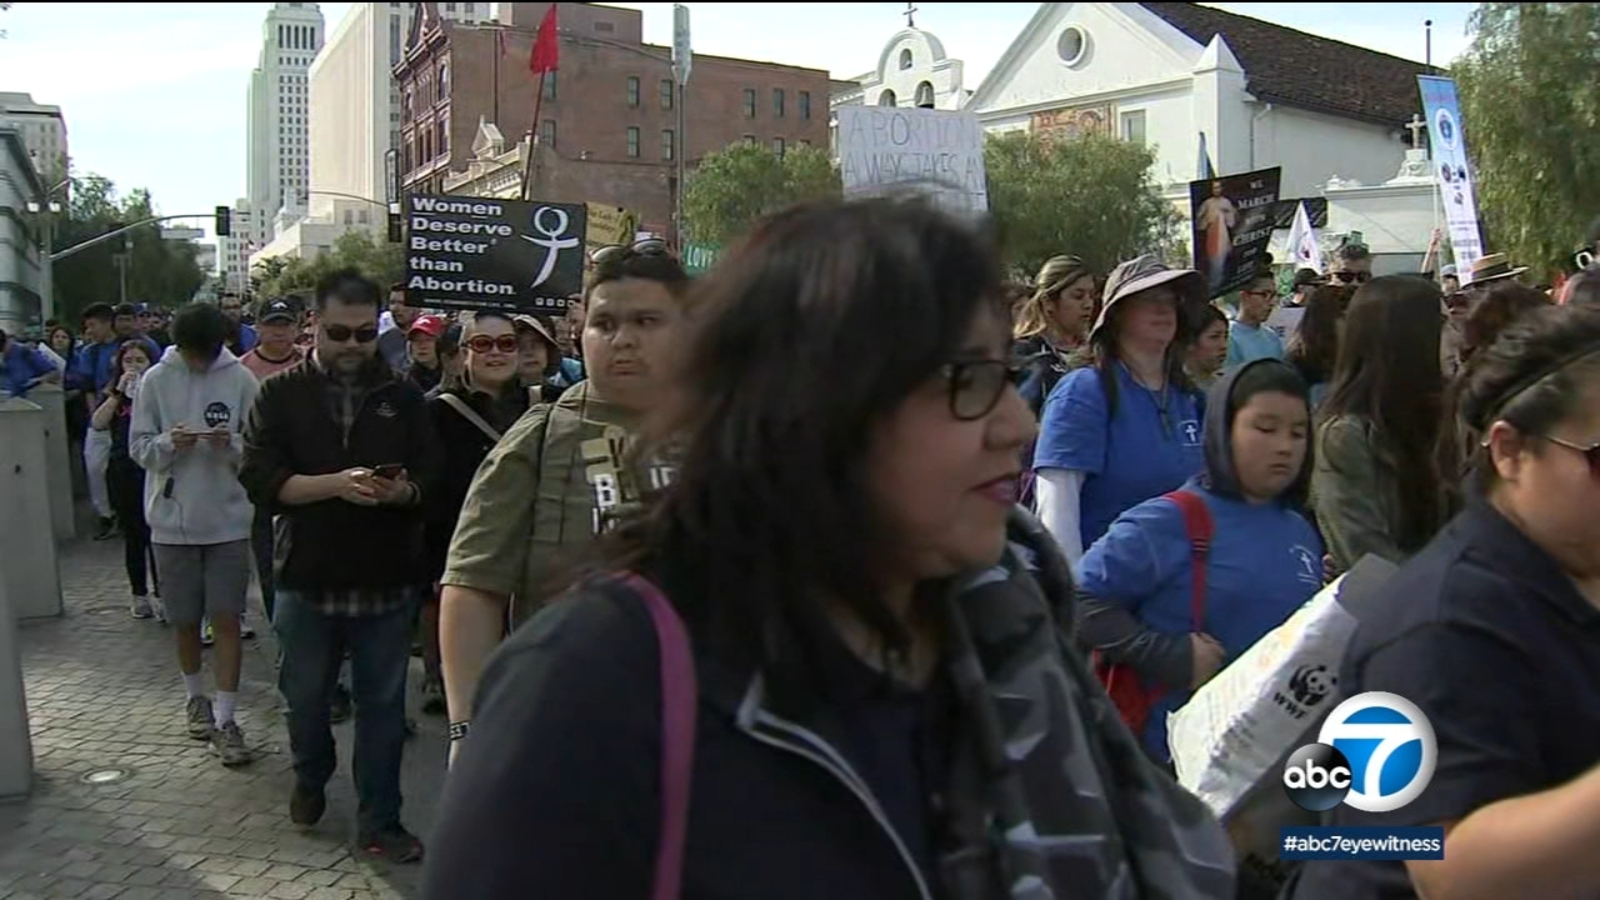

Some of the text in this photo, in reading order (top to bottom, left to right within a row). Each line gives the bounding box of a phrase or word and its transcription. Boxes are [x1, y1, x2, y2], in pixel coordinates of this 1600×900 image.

[412, 197, 503, 216] Women
[411, 216, 513, 237] Deserve
[409, 255, 464, 273] than
